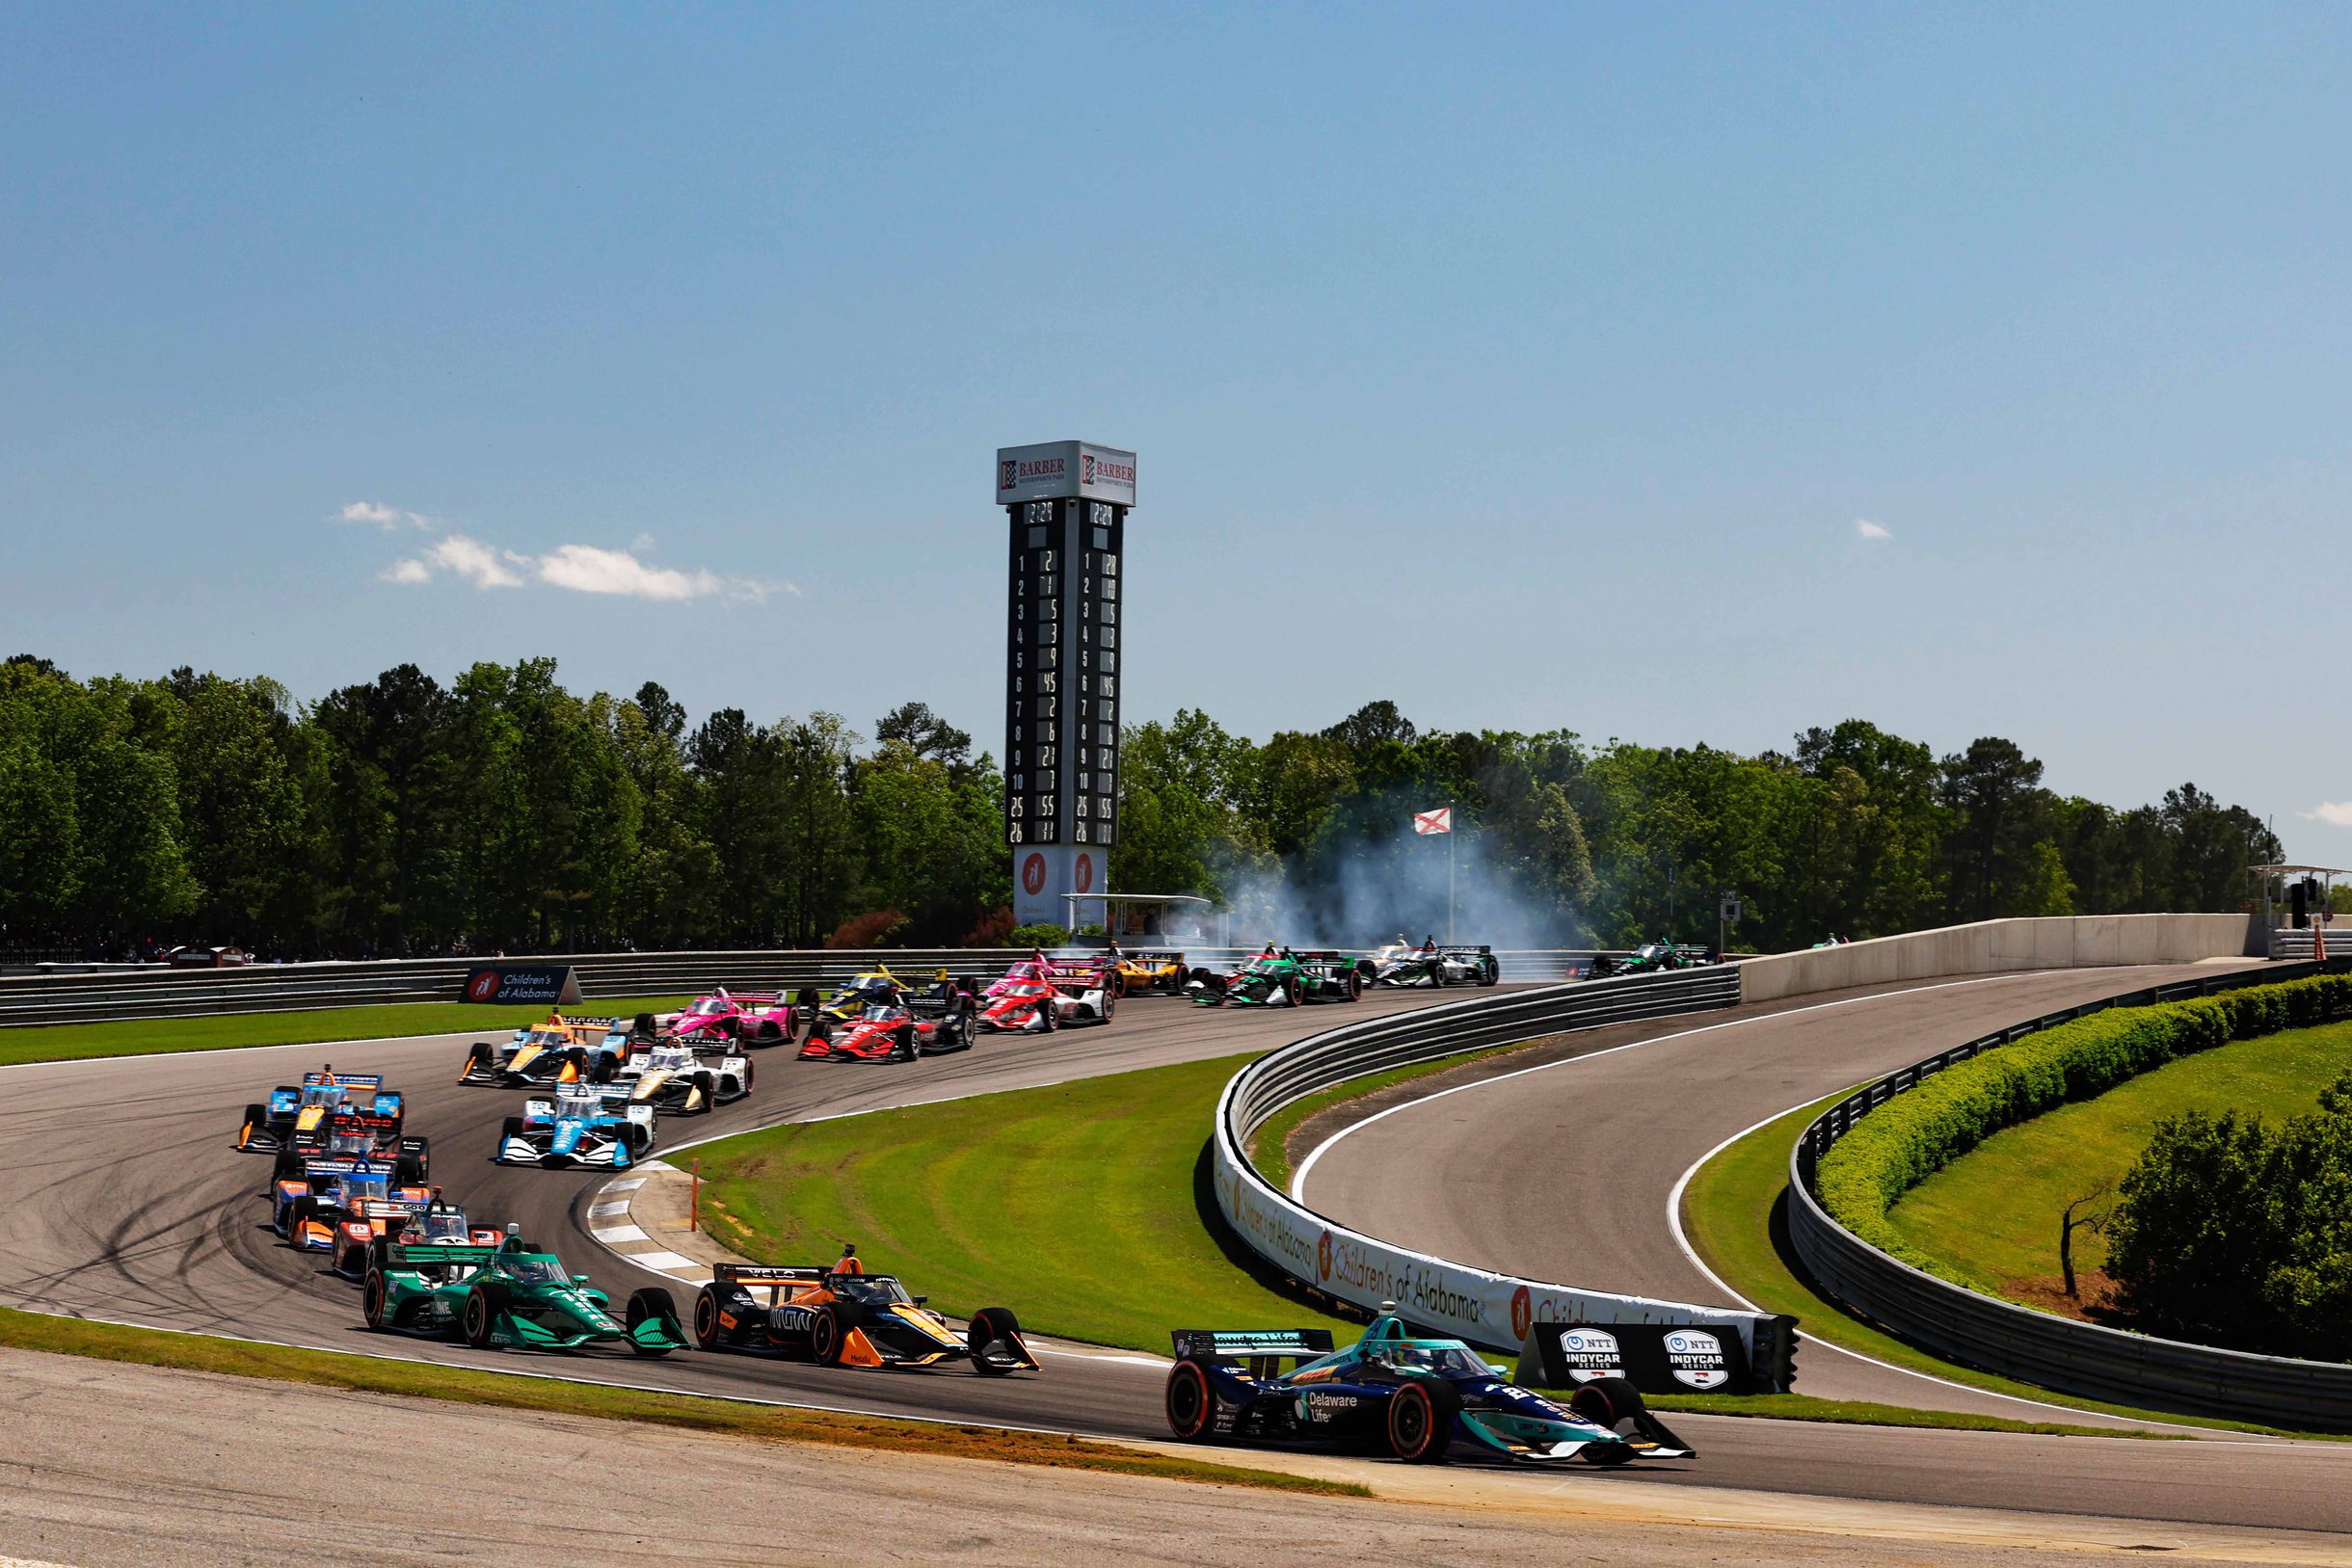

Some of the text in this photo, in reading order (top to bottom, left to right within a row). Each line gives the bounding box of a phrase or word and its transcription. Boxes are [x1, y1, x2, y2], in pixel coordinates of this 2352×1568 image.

[1019, 458, 1065, 477] BARBER
[1096, 462, 1135, 482] BARBER
[1019, 555, 1024, 571] 1
[1085, 553, 1116, 575] 1 28
[1018, 580, 1024, 596] 2
[1083, 577, 1089, 594] 2
[1018, 599, 1056, 620] 3 5
[1083, 601, 1114, 625] 3 5
[1017, 623, 1056, 644] 4 3
[1083, 626, 1114, 648] 4 3
[1017, 648, 1056, 669] 5 9
[1082, 651, 1087, 667] 5
[1016, 672, 1056, 692] 6 45
[1082, 675, 1087, 692] 6
[1016, 696, 1056, 717] 7 2
[1082, 700, 1114, 721] 7 2
[1015, 725, 1022, 742] 8
[1082, 724, 1087, 740] 8
[1015, 746, 1055, 767] 9 21
[1082, 748, 1112, 769] 9 21
[1012, 769, 1055, 790] 10 7
[1080, 773, 1112, 794] 10 7
[1010, 796, 1054, 817] 25 55
[1077, 796, 1111, 819] 25 55
[1010, 822, 1022, 842] 26
[1076, 821, 1087, 842] 26
[503, 974, 551, 985] Children's
[497, 987, 556, 998] of Alabama
[1334, 1243, 1480, 1323] Children's of Alabama
[491, 1336, 511, 1344] LEGION
[1587, 1339, 1612, 1348] NTT
[1690, 1341, 1714, 1349] NTT
[1566, 1353, 1621, 1363] INDYCAR
[1670, 1355, 1724, 1365] INDYCAR
[1309, 1392, 1357, 1407] Delaware
[1311, 1409, 1329, 1422] Life
